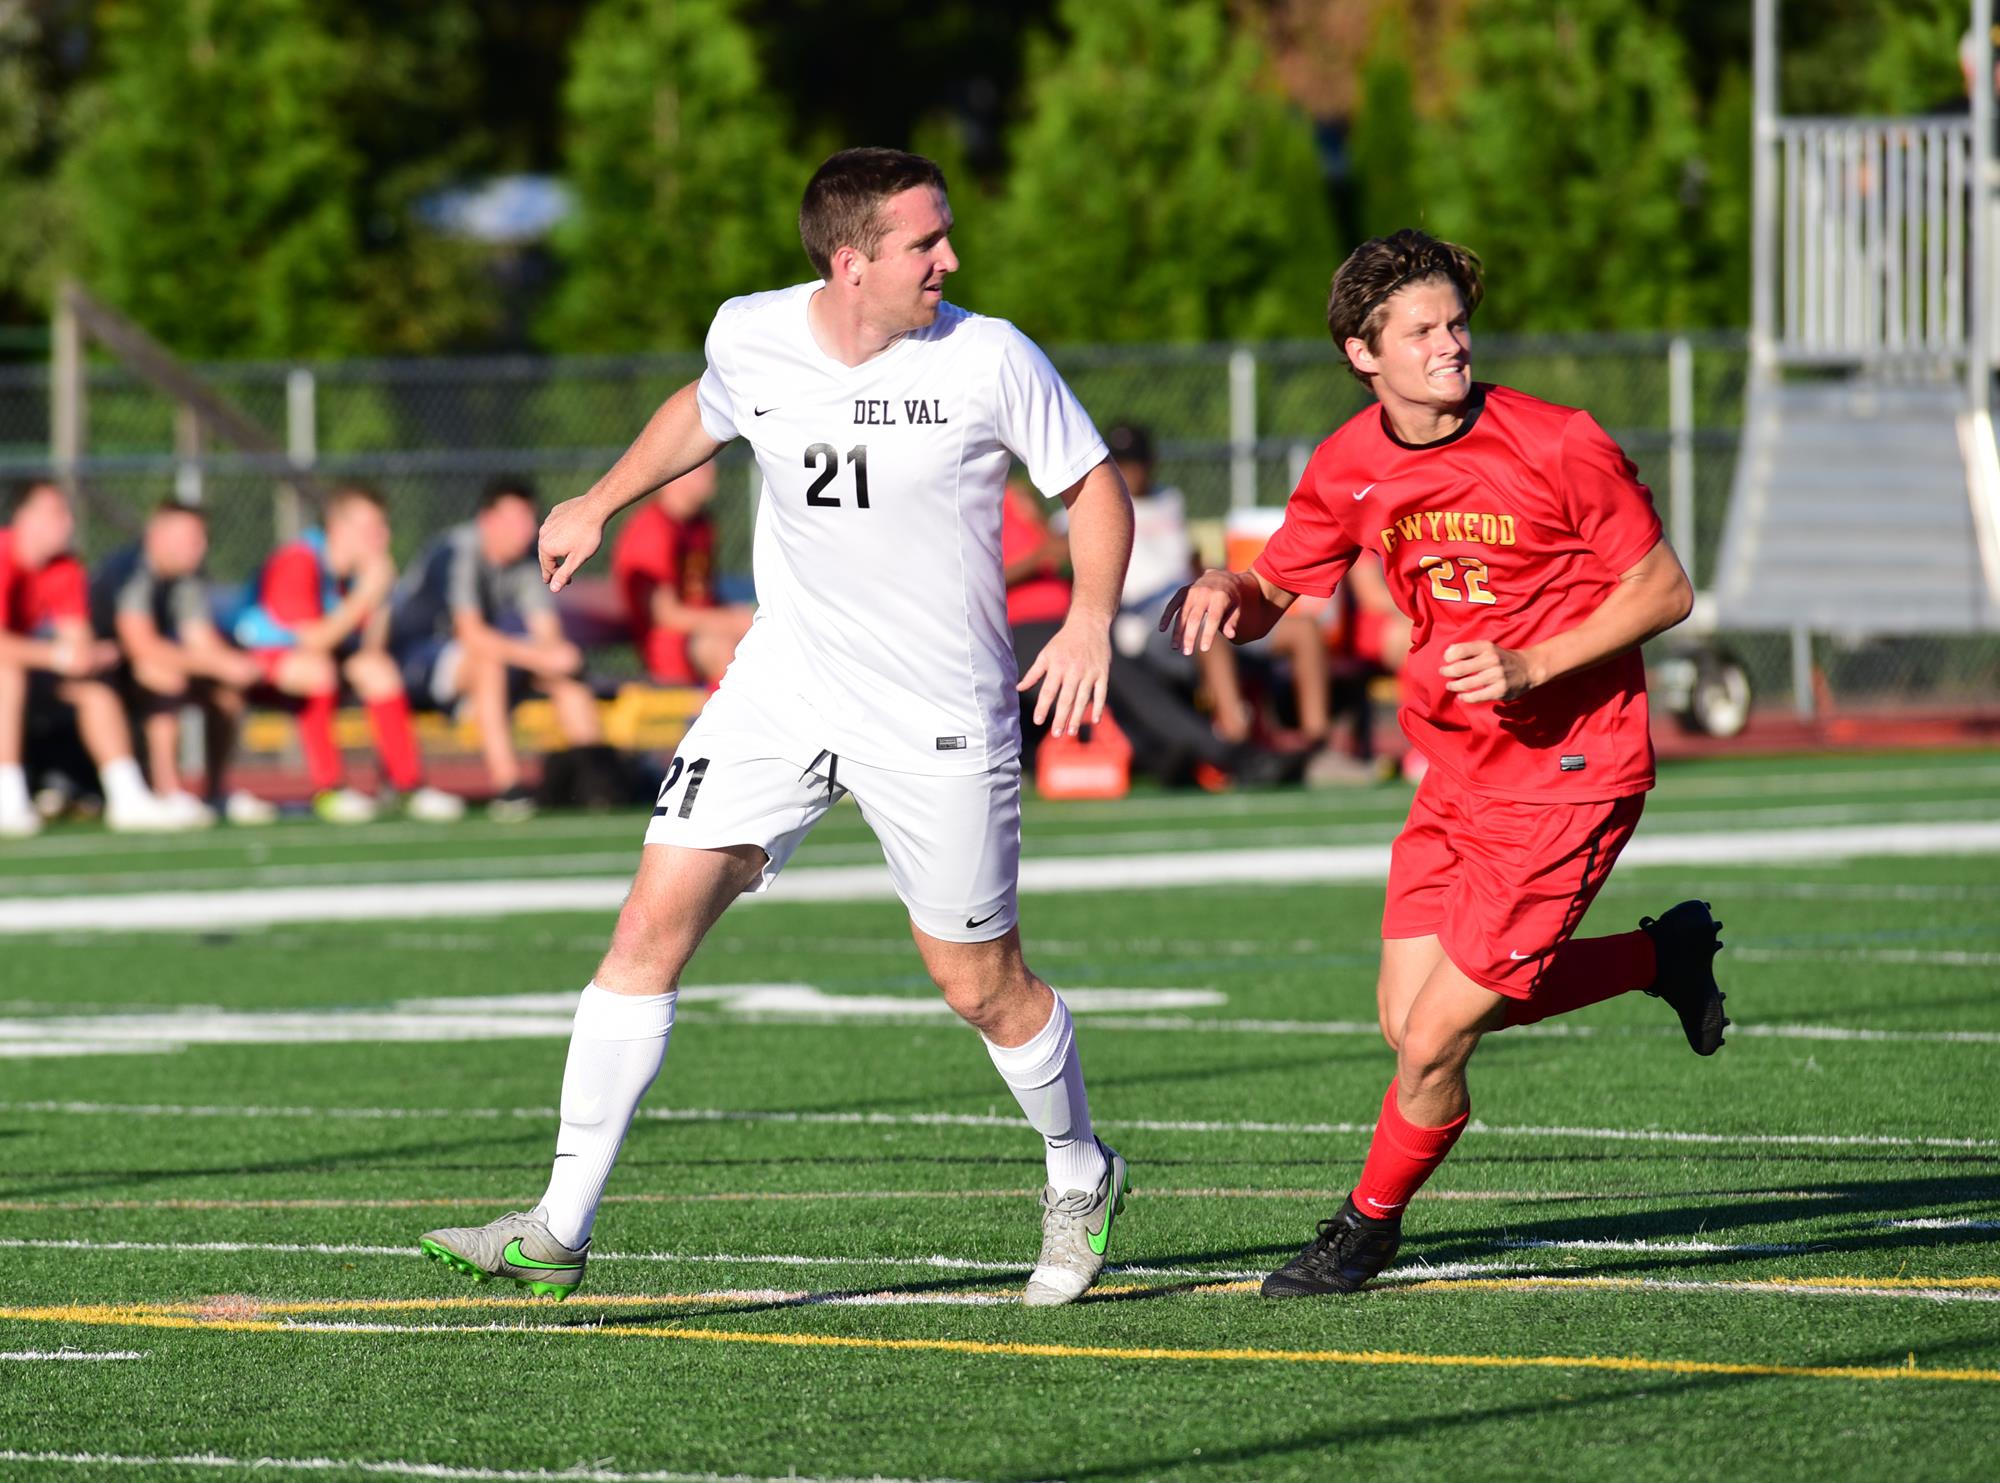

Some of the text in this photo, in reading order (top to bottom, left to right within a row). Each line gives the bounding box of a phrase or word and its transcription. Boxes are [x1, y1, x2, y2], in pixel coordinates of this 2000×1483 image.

[853, 399, 948, 425] DEL VAL
[803, 442, 871, 509] 21
[1380, 511, 1517, 554] GWYNEDD
[1418, 555, 1498, 606] 22
[651, 756, 711, 820] 21
